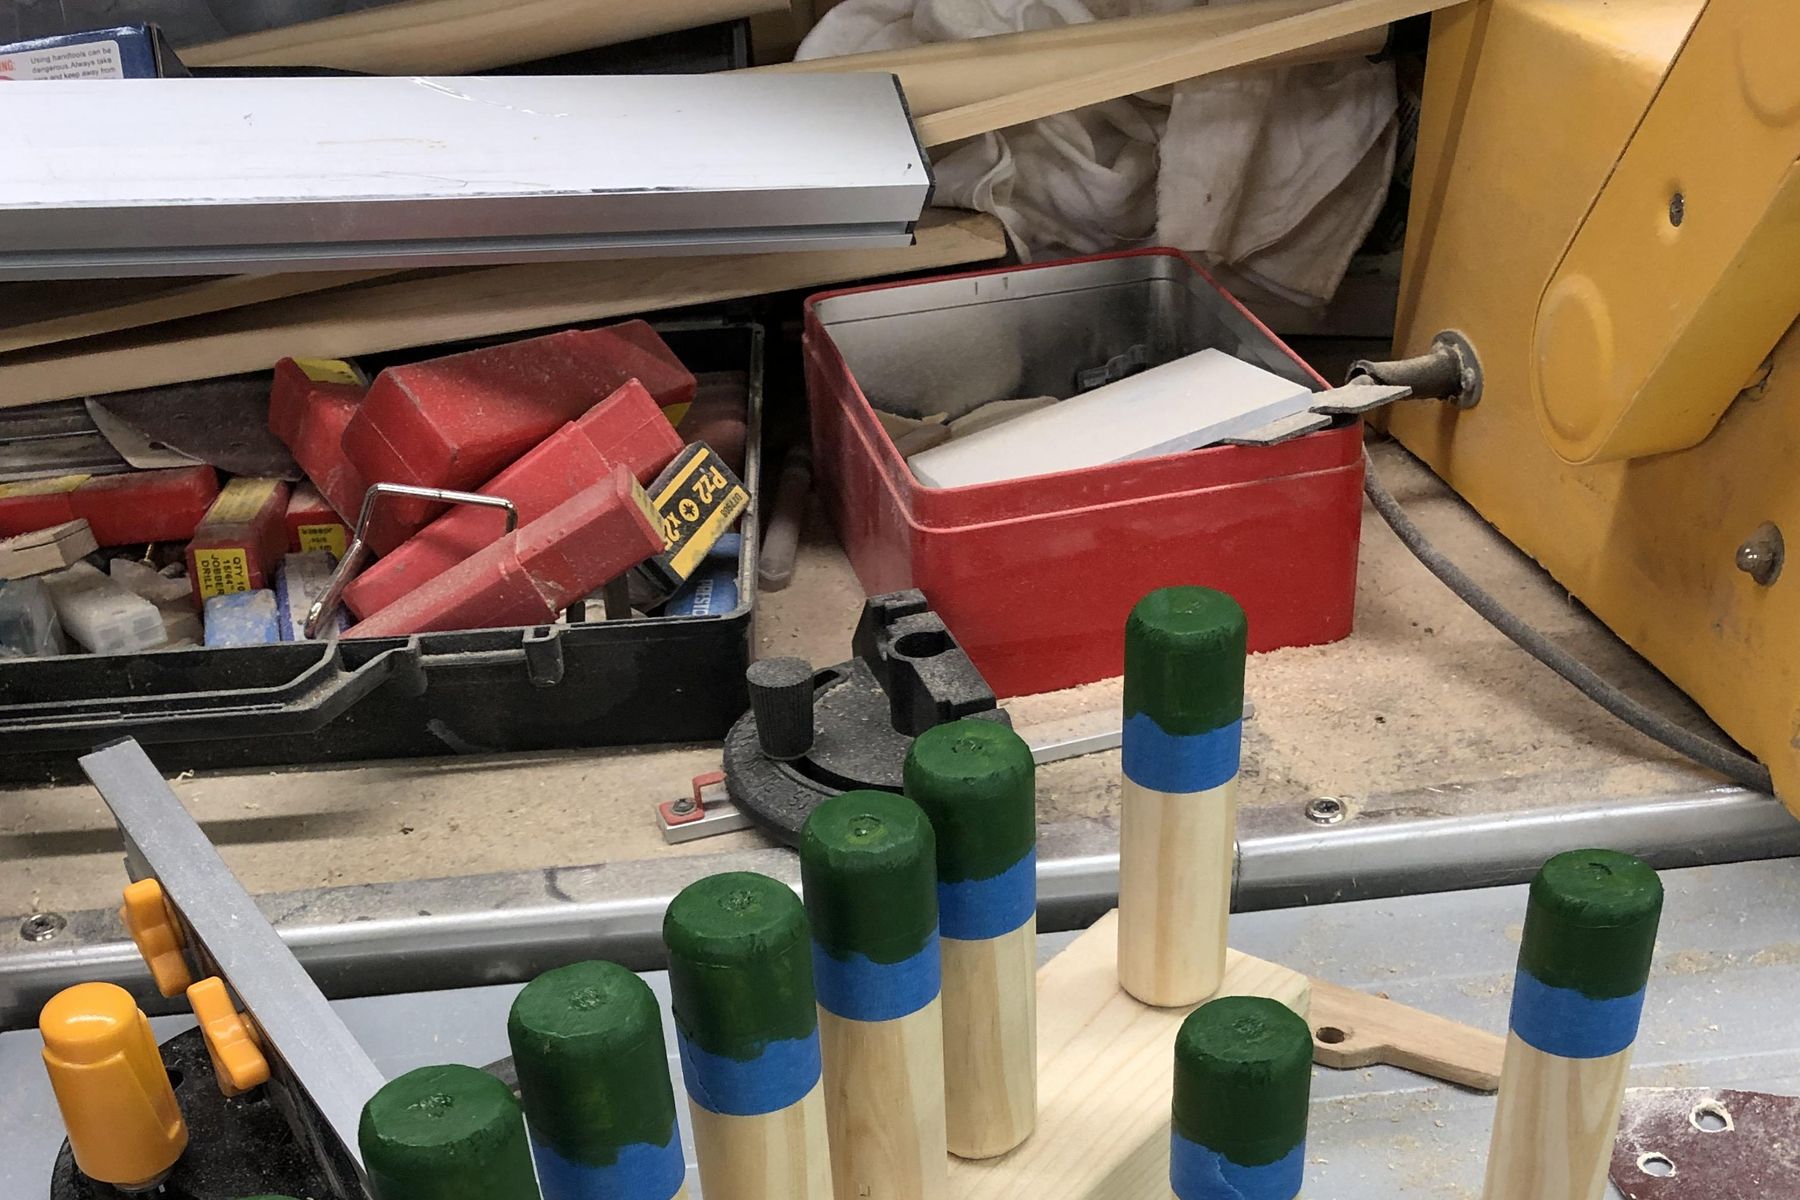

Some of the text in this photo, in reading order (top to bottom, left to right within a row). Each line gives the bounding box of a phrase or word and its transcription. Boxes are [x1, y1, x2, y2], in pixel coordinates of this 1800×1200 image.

[30, 56, 51, 65] Using
[201, 560, 213, 590] DRILL
[233, 556, 246, 591] QTY 10
